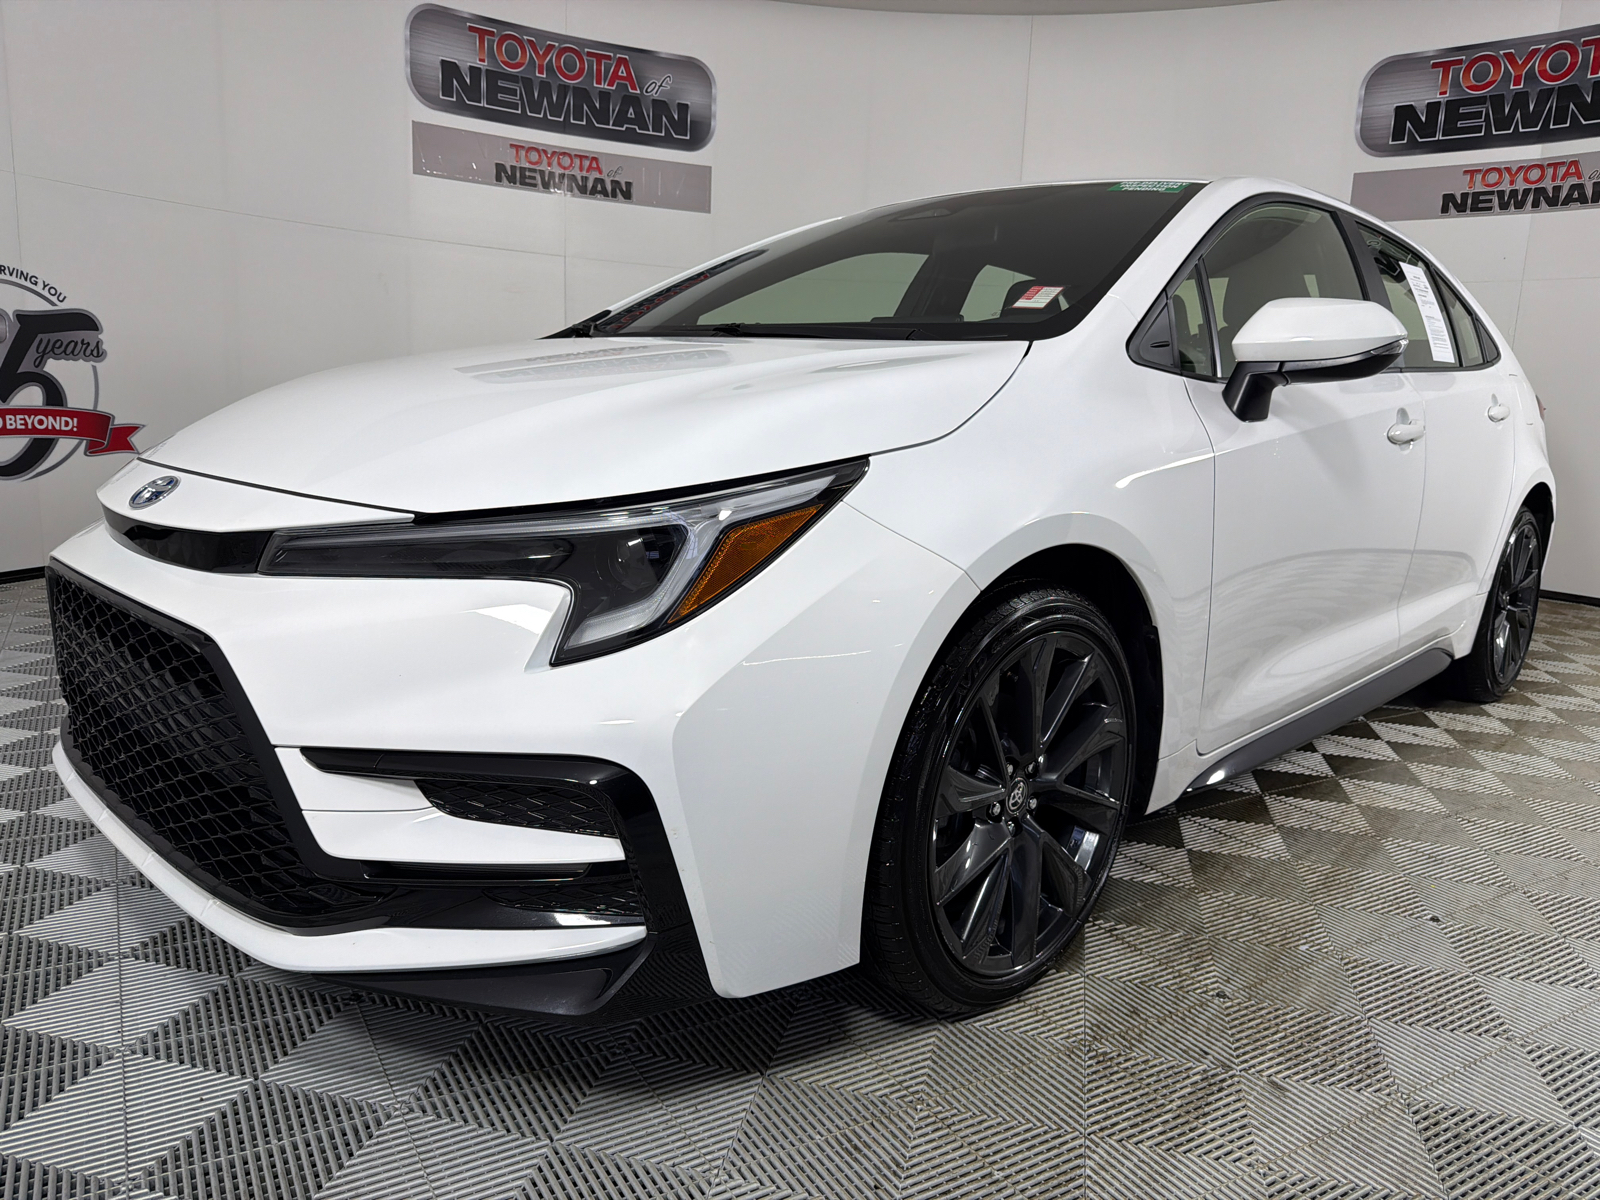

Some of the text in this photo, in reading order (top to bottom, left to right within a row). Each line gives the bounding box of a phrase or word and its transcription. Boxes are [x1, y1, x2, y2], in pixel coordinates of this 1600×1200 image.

[467, 23, 639, 93] TOYOTA
[440, 58, 691, 139] NEWNAN
[644, 74, 672, 96] of
[1389, 81, 1600, 144] NEWN
[509, 143, 603, 175] TOYOTA
[607, 166, 623, 178] of
[1463, 159, 1584, 189] TOYOTA
[495, 162, 633, 201] NEWNAN
[41, 279, 67, 303] YOU
[33, 334, 104, 368] years
[6, 415, 78, 431] BEYOND!
